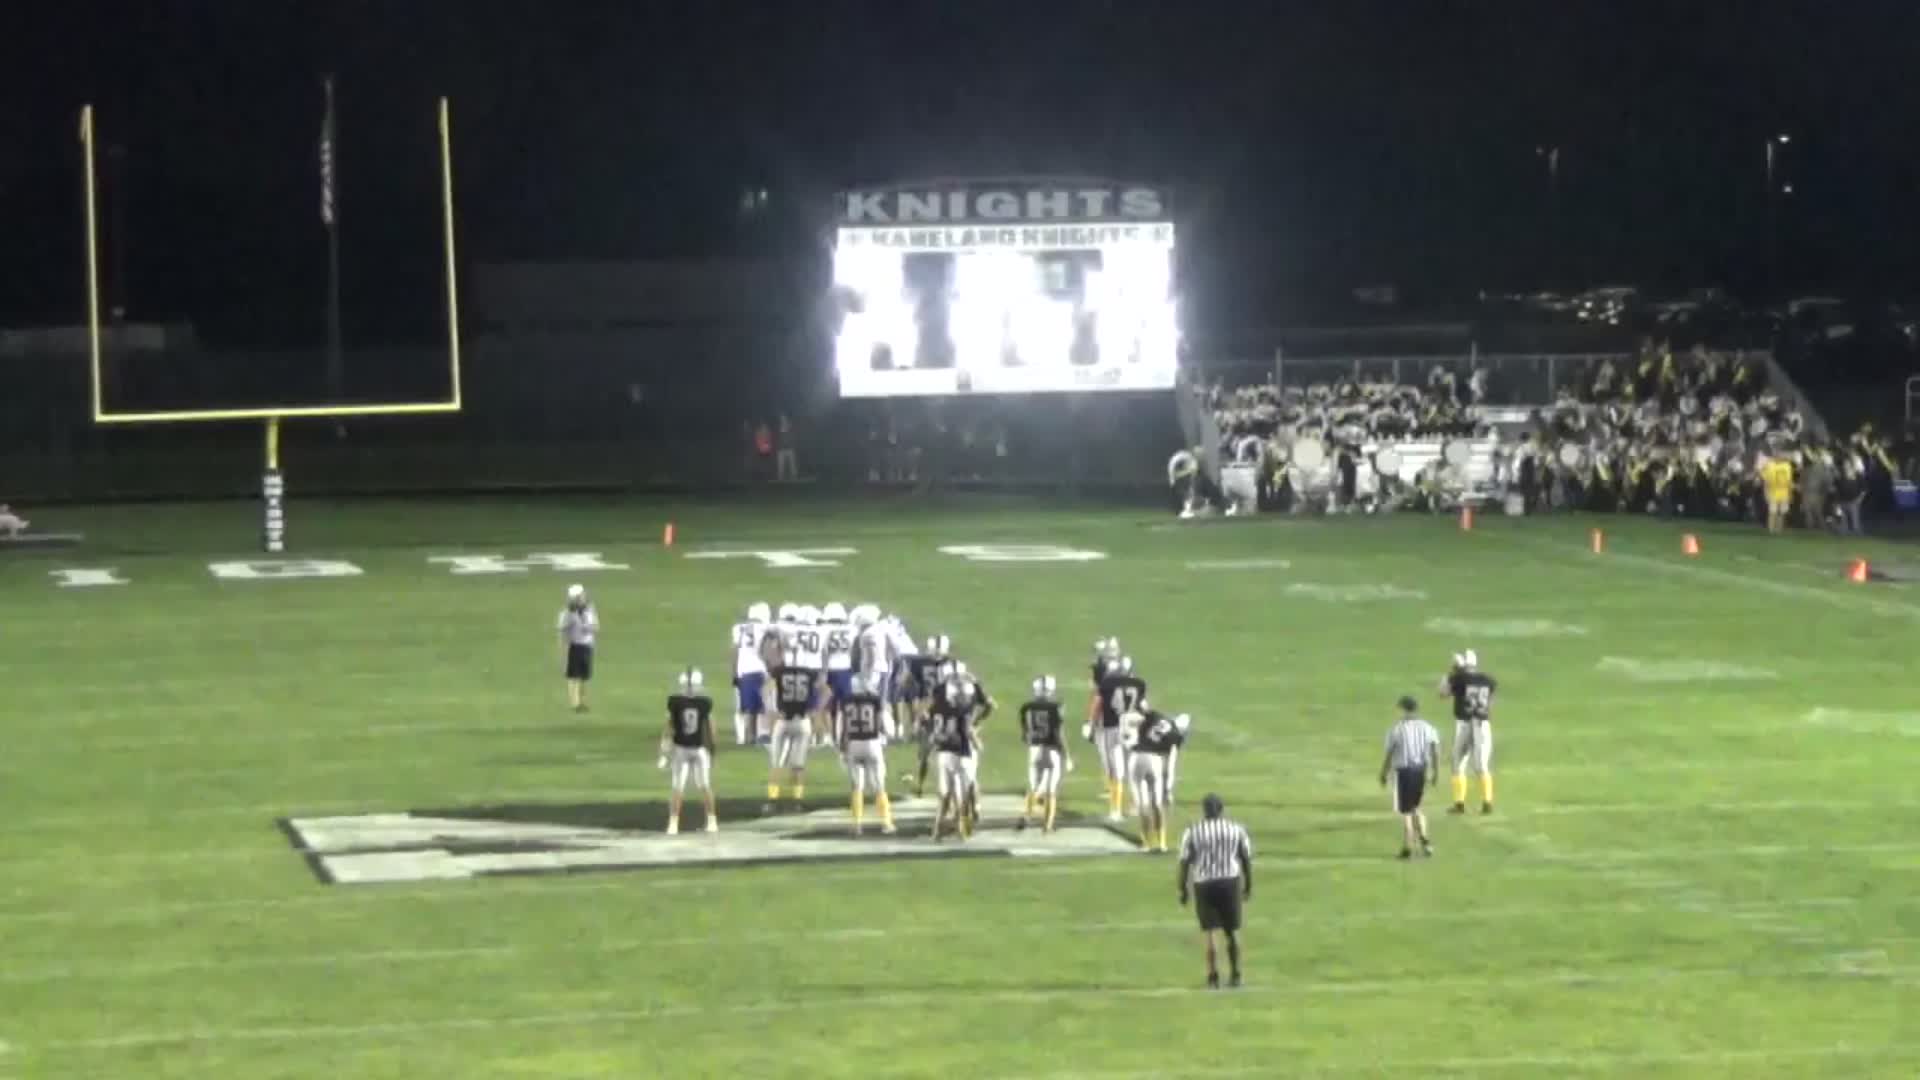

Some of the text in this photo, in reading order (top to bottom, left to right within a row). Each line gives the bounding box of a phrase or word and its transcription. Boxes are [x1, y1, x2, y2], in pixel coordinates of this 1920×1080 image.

[847, 189, 1162, 221] KNIGHTS
[797, 631, 819, 653] 50
[782, 674, 809, 701] 56
[1111, 687, 1138, 713] 47
[683, 708, 699, 734] 9
[845, 704, 874, 733] 29
